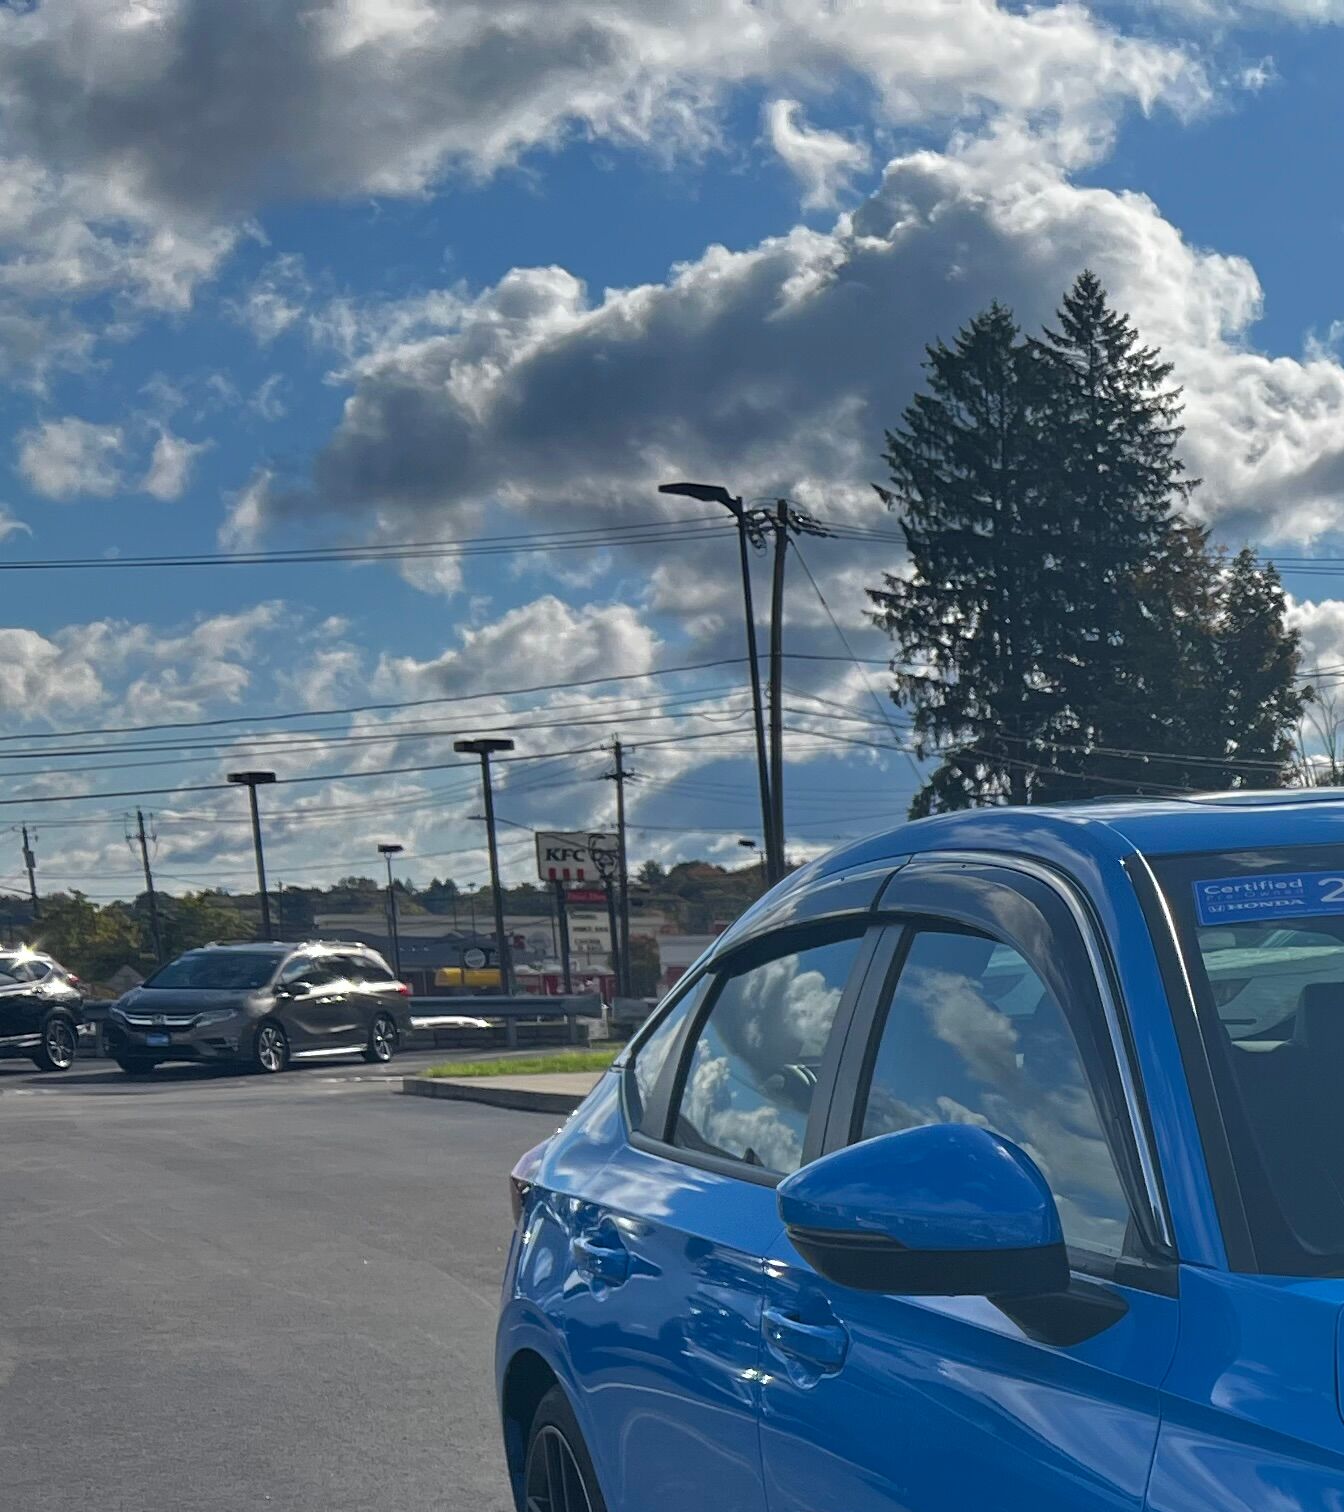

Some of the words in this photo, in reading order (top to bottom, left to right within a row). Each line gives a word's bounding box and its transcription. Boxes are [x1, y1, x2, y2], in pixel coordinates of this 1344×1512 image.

[546, 848, 586, 862] KFC
[1204, 878, 1303, 894] Certified
[1227, 899, 1306, 911] HONDA
